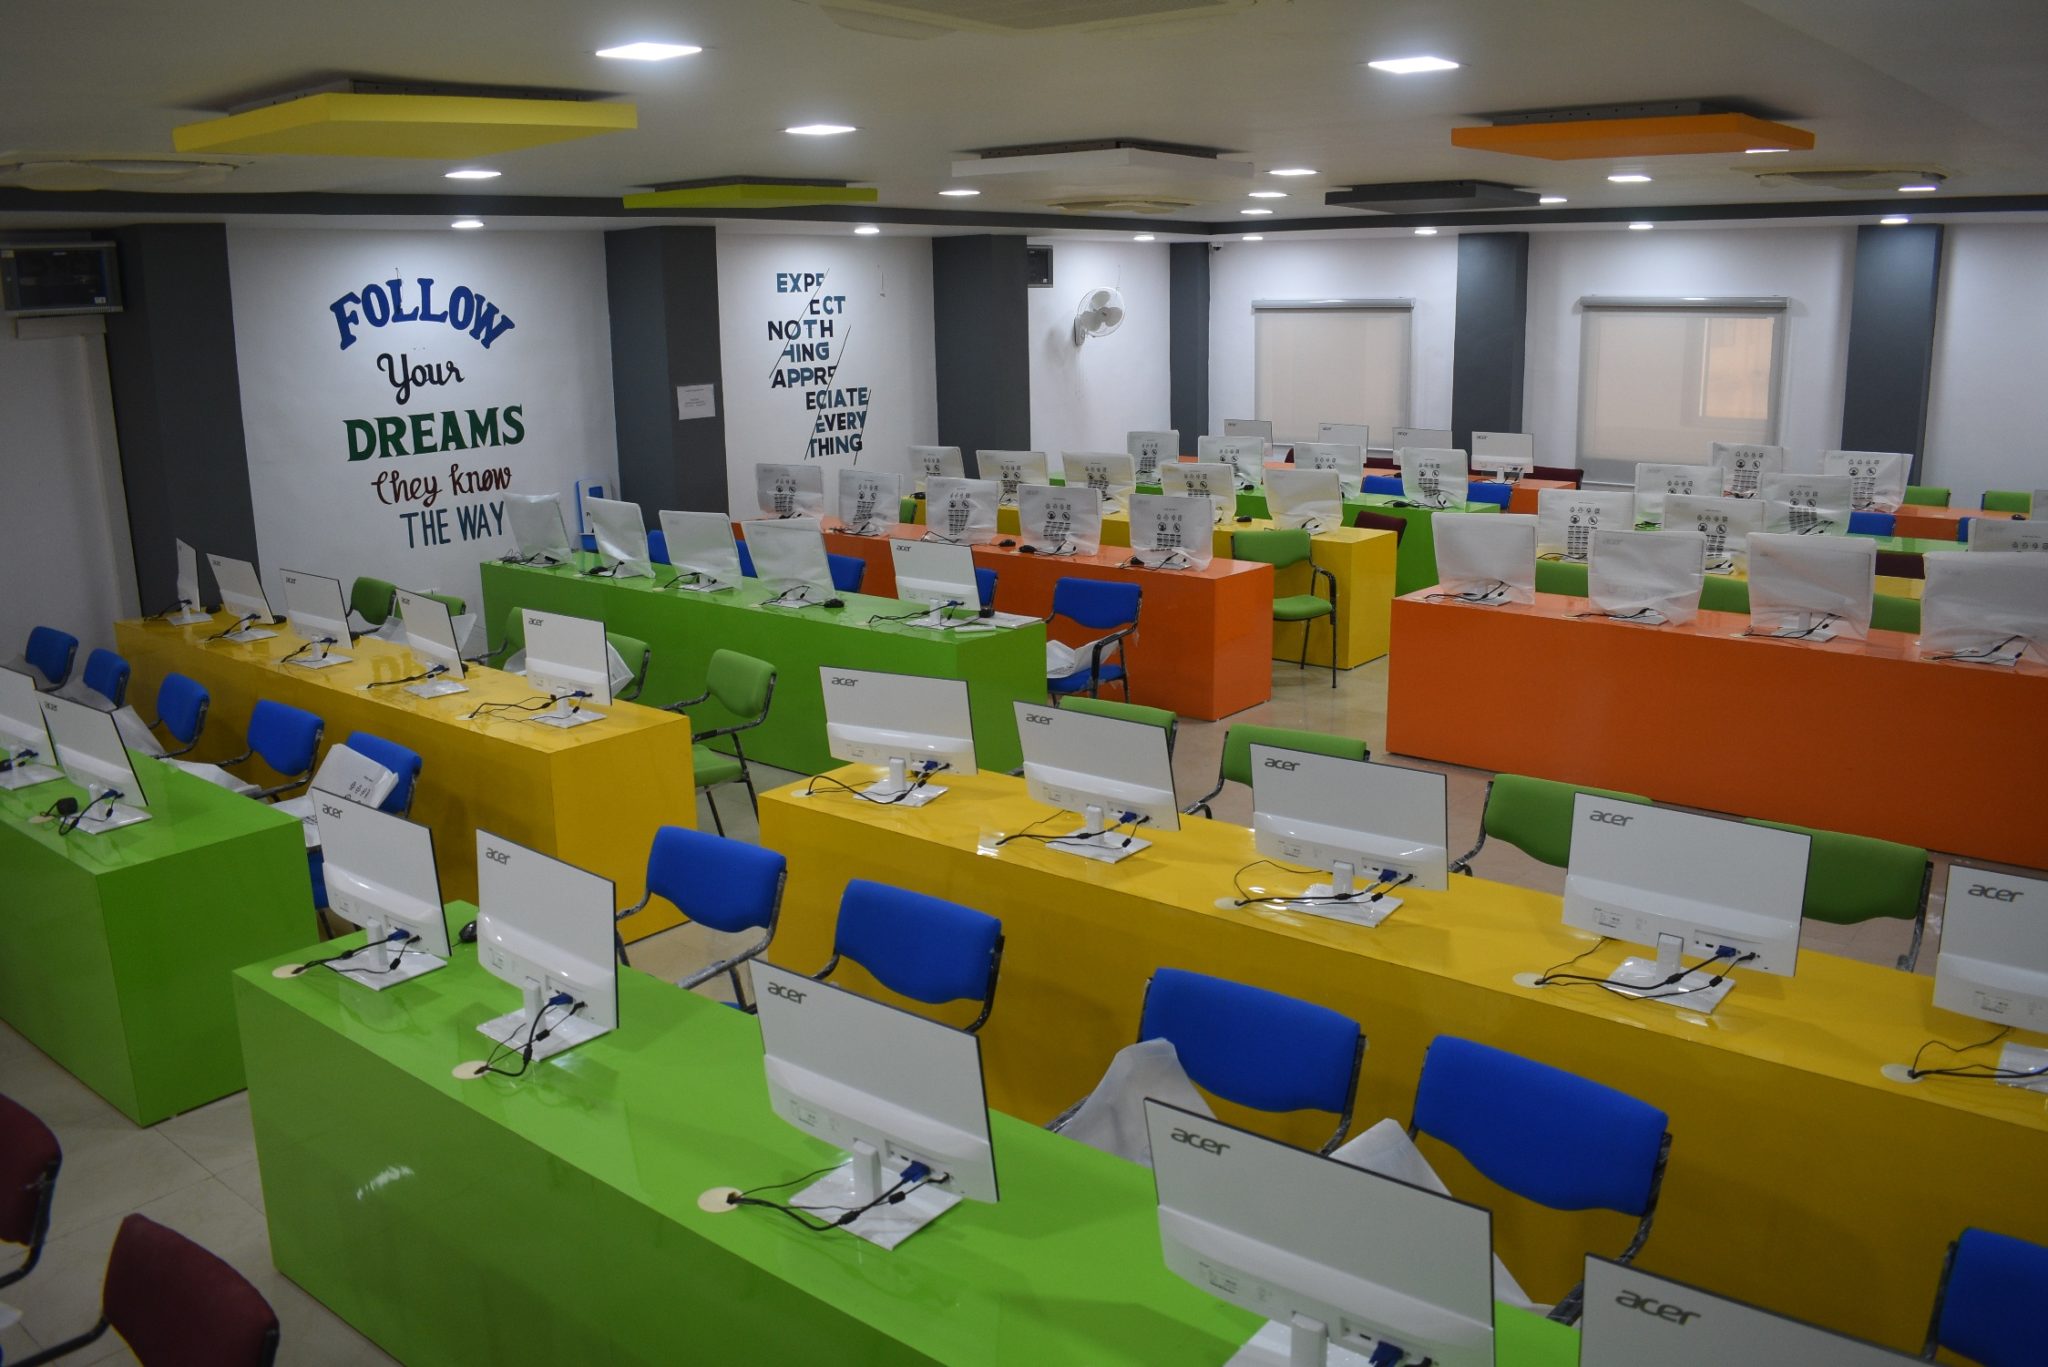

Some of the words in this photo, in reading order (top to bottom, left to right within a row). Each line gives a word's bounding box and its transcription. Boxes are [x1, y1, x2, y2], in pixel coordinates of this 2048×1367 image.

[330, 278, 515, 350] FOLLOW
[768, 319, 834, 341] NOTH
[376, 353, 465, 405] Your
[806, 387, 869, 410] ECIATE
[342, 404, 526, 462] DREAMS
[815, 410, 867, 433] EVERY
[809, 433, 863, 458] THING
[449, 463, 512, 496] know
[400, 508, 451, 549] THE
[456, 501, 504, 542] WAY
[528, 618, 544, 626] acer
[831, 676, 859, 687] acer
[1025, 713, 1053, 725] acer
[1264, 758, 1300, 771] acer
[322, 803, 343, 819] acer
[1589, 810, 1634, 827] acer
[485, 847, 510, 865] acer
[1968, 884, 2024, 902] acer
[767, 981, 807, 1004] acer
[1170, 1127, 1231, 1155] acer
[1615, 1289, 1702, 1326] acer
